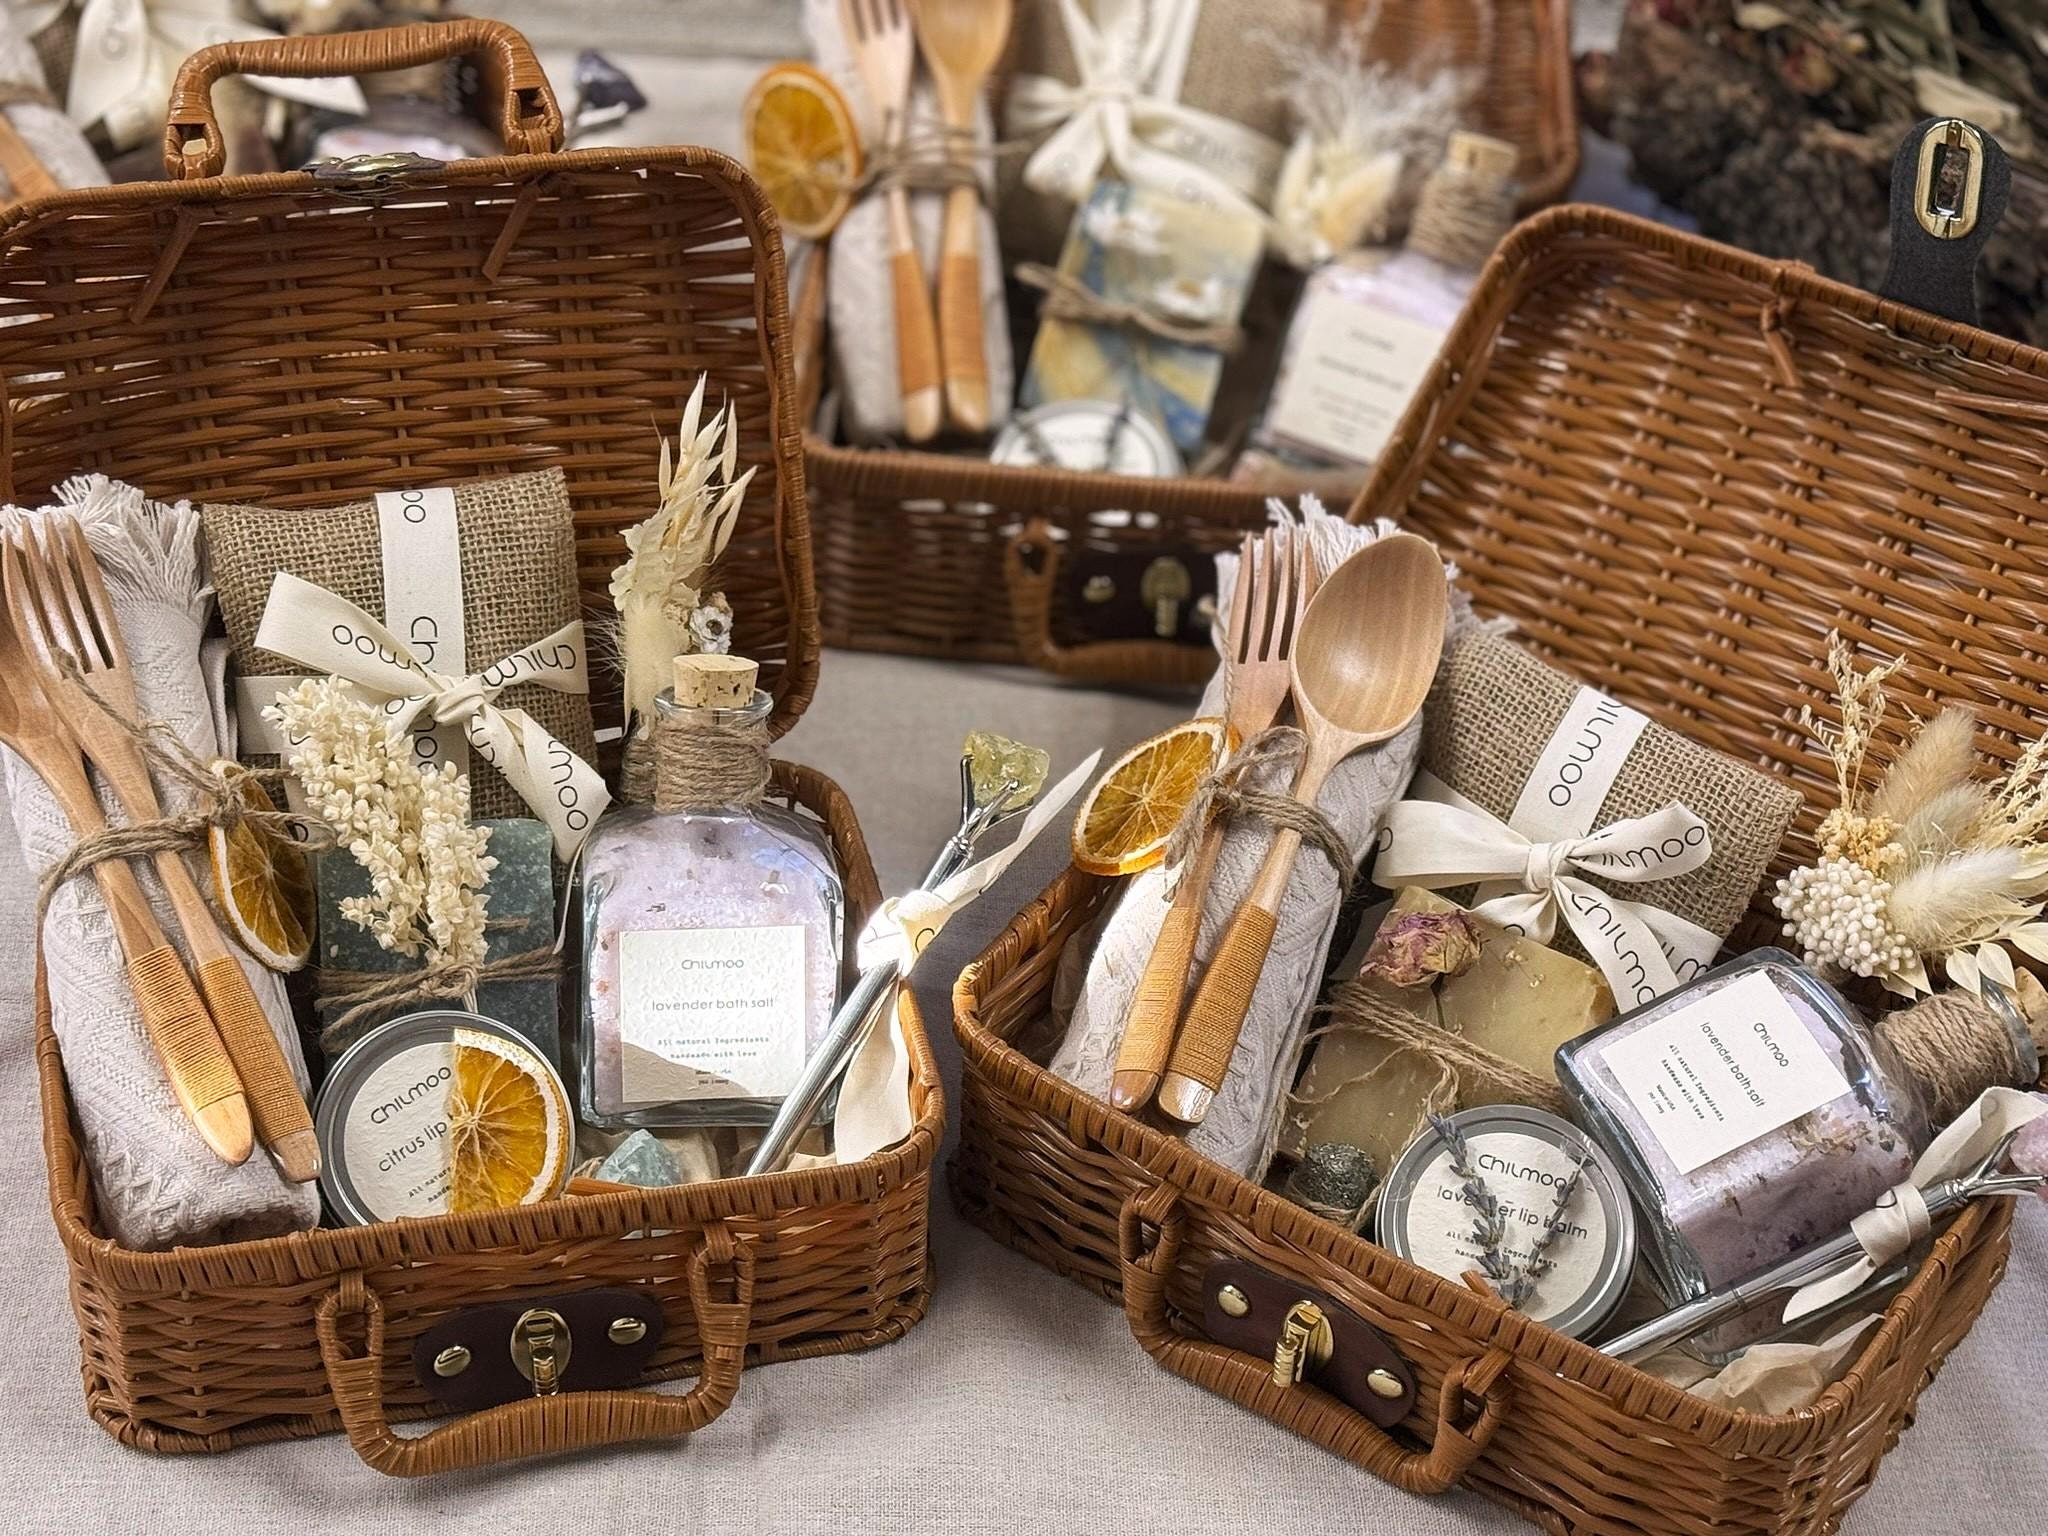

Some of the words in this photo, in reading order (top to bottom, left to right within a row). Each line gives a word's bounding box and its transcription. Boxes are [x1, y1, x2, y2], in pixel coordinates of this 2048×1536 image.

[652, 1000, 713, 1012] lavender
[716, 999, 748, 1010] bath
[751, 998, 774, 1009] salt
[1700, 1022, 1735, 1066] lavender
[1730, 1064, 1752, 1091] bath
[1746, 1088, 1766, 1108] salt
[378, 1135, 426, 1173] citrus
[424, 1120, 448, 1142] lip
[1437, 1185, 1515, 1219] laveer
[1518, 1207, 1539, 1226] lip
